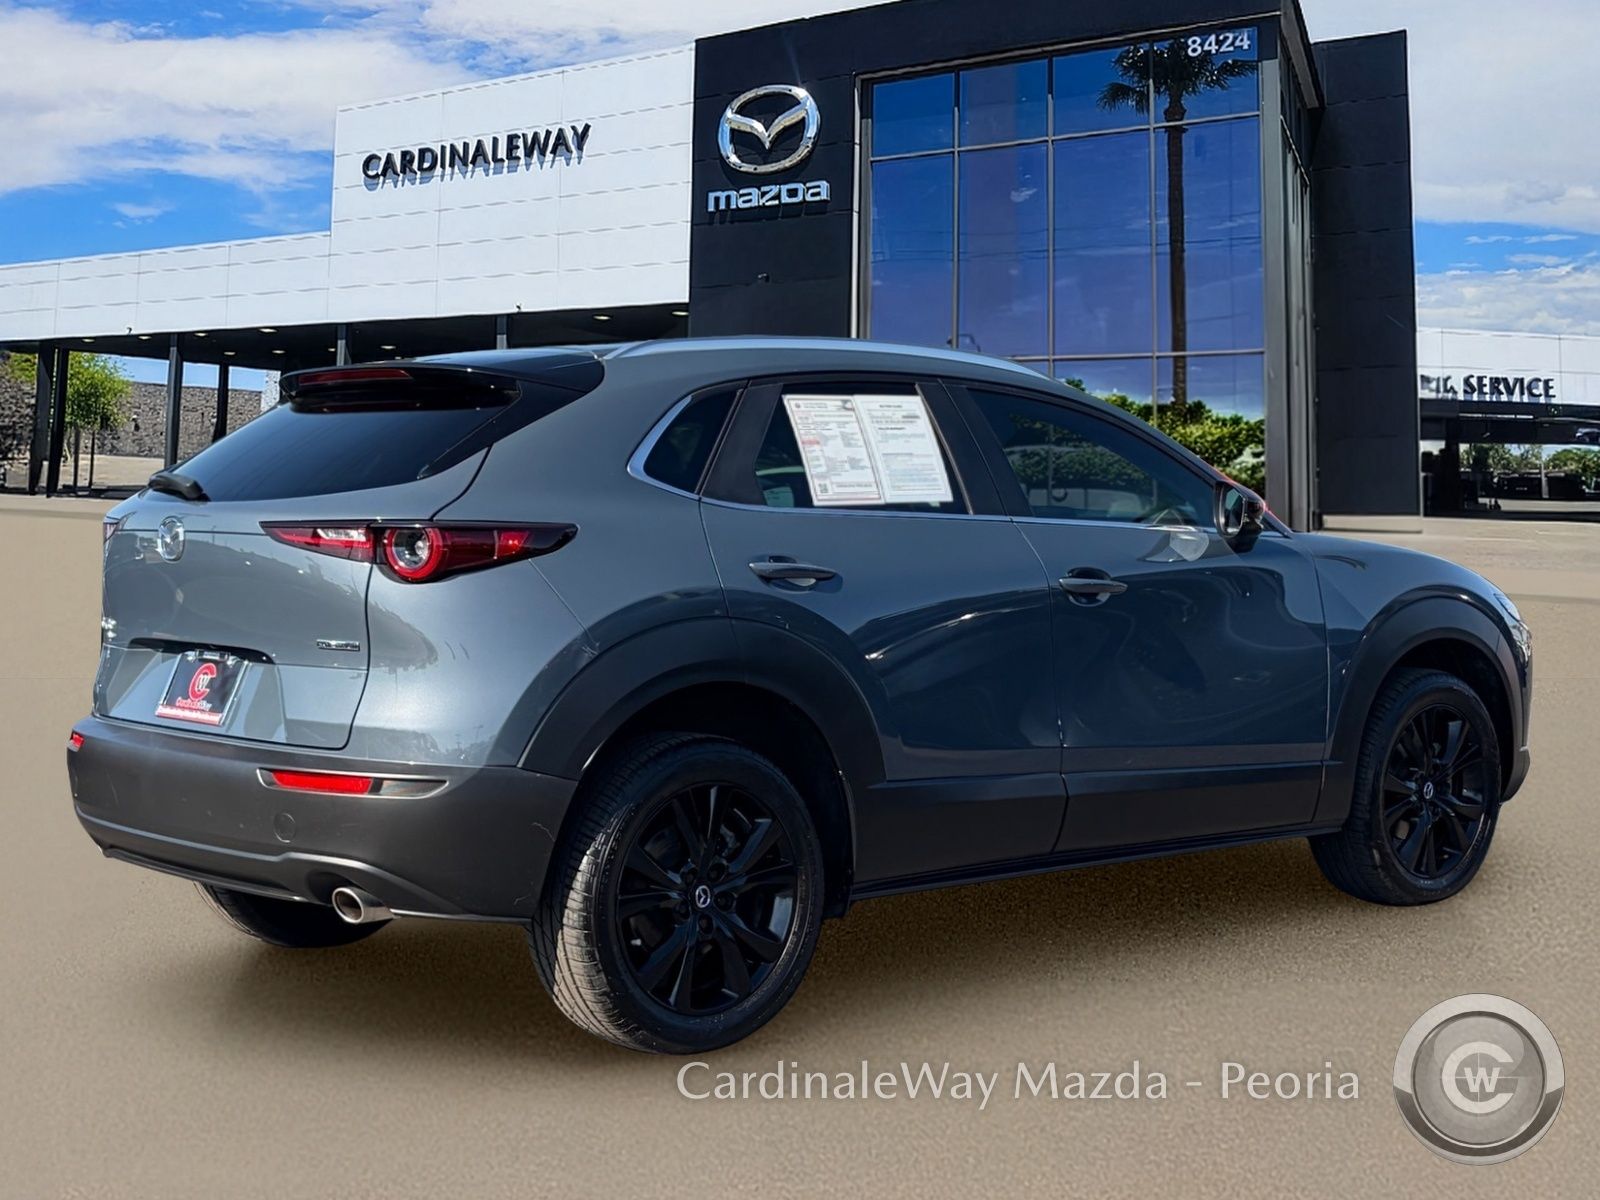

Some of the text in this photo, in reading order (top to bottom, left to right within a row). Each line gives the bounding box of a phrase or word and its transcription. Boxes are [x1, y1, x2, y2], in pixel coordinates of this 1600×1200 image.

[1187, 30, 1251, 57] 8424
[362, 123, 591, 180] CARDINALEWAY
[707, 180, 830, 212] mazda
[1463, 374, 1556, 398] SERVICE
